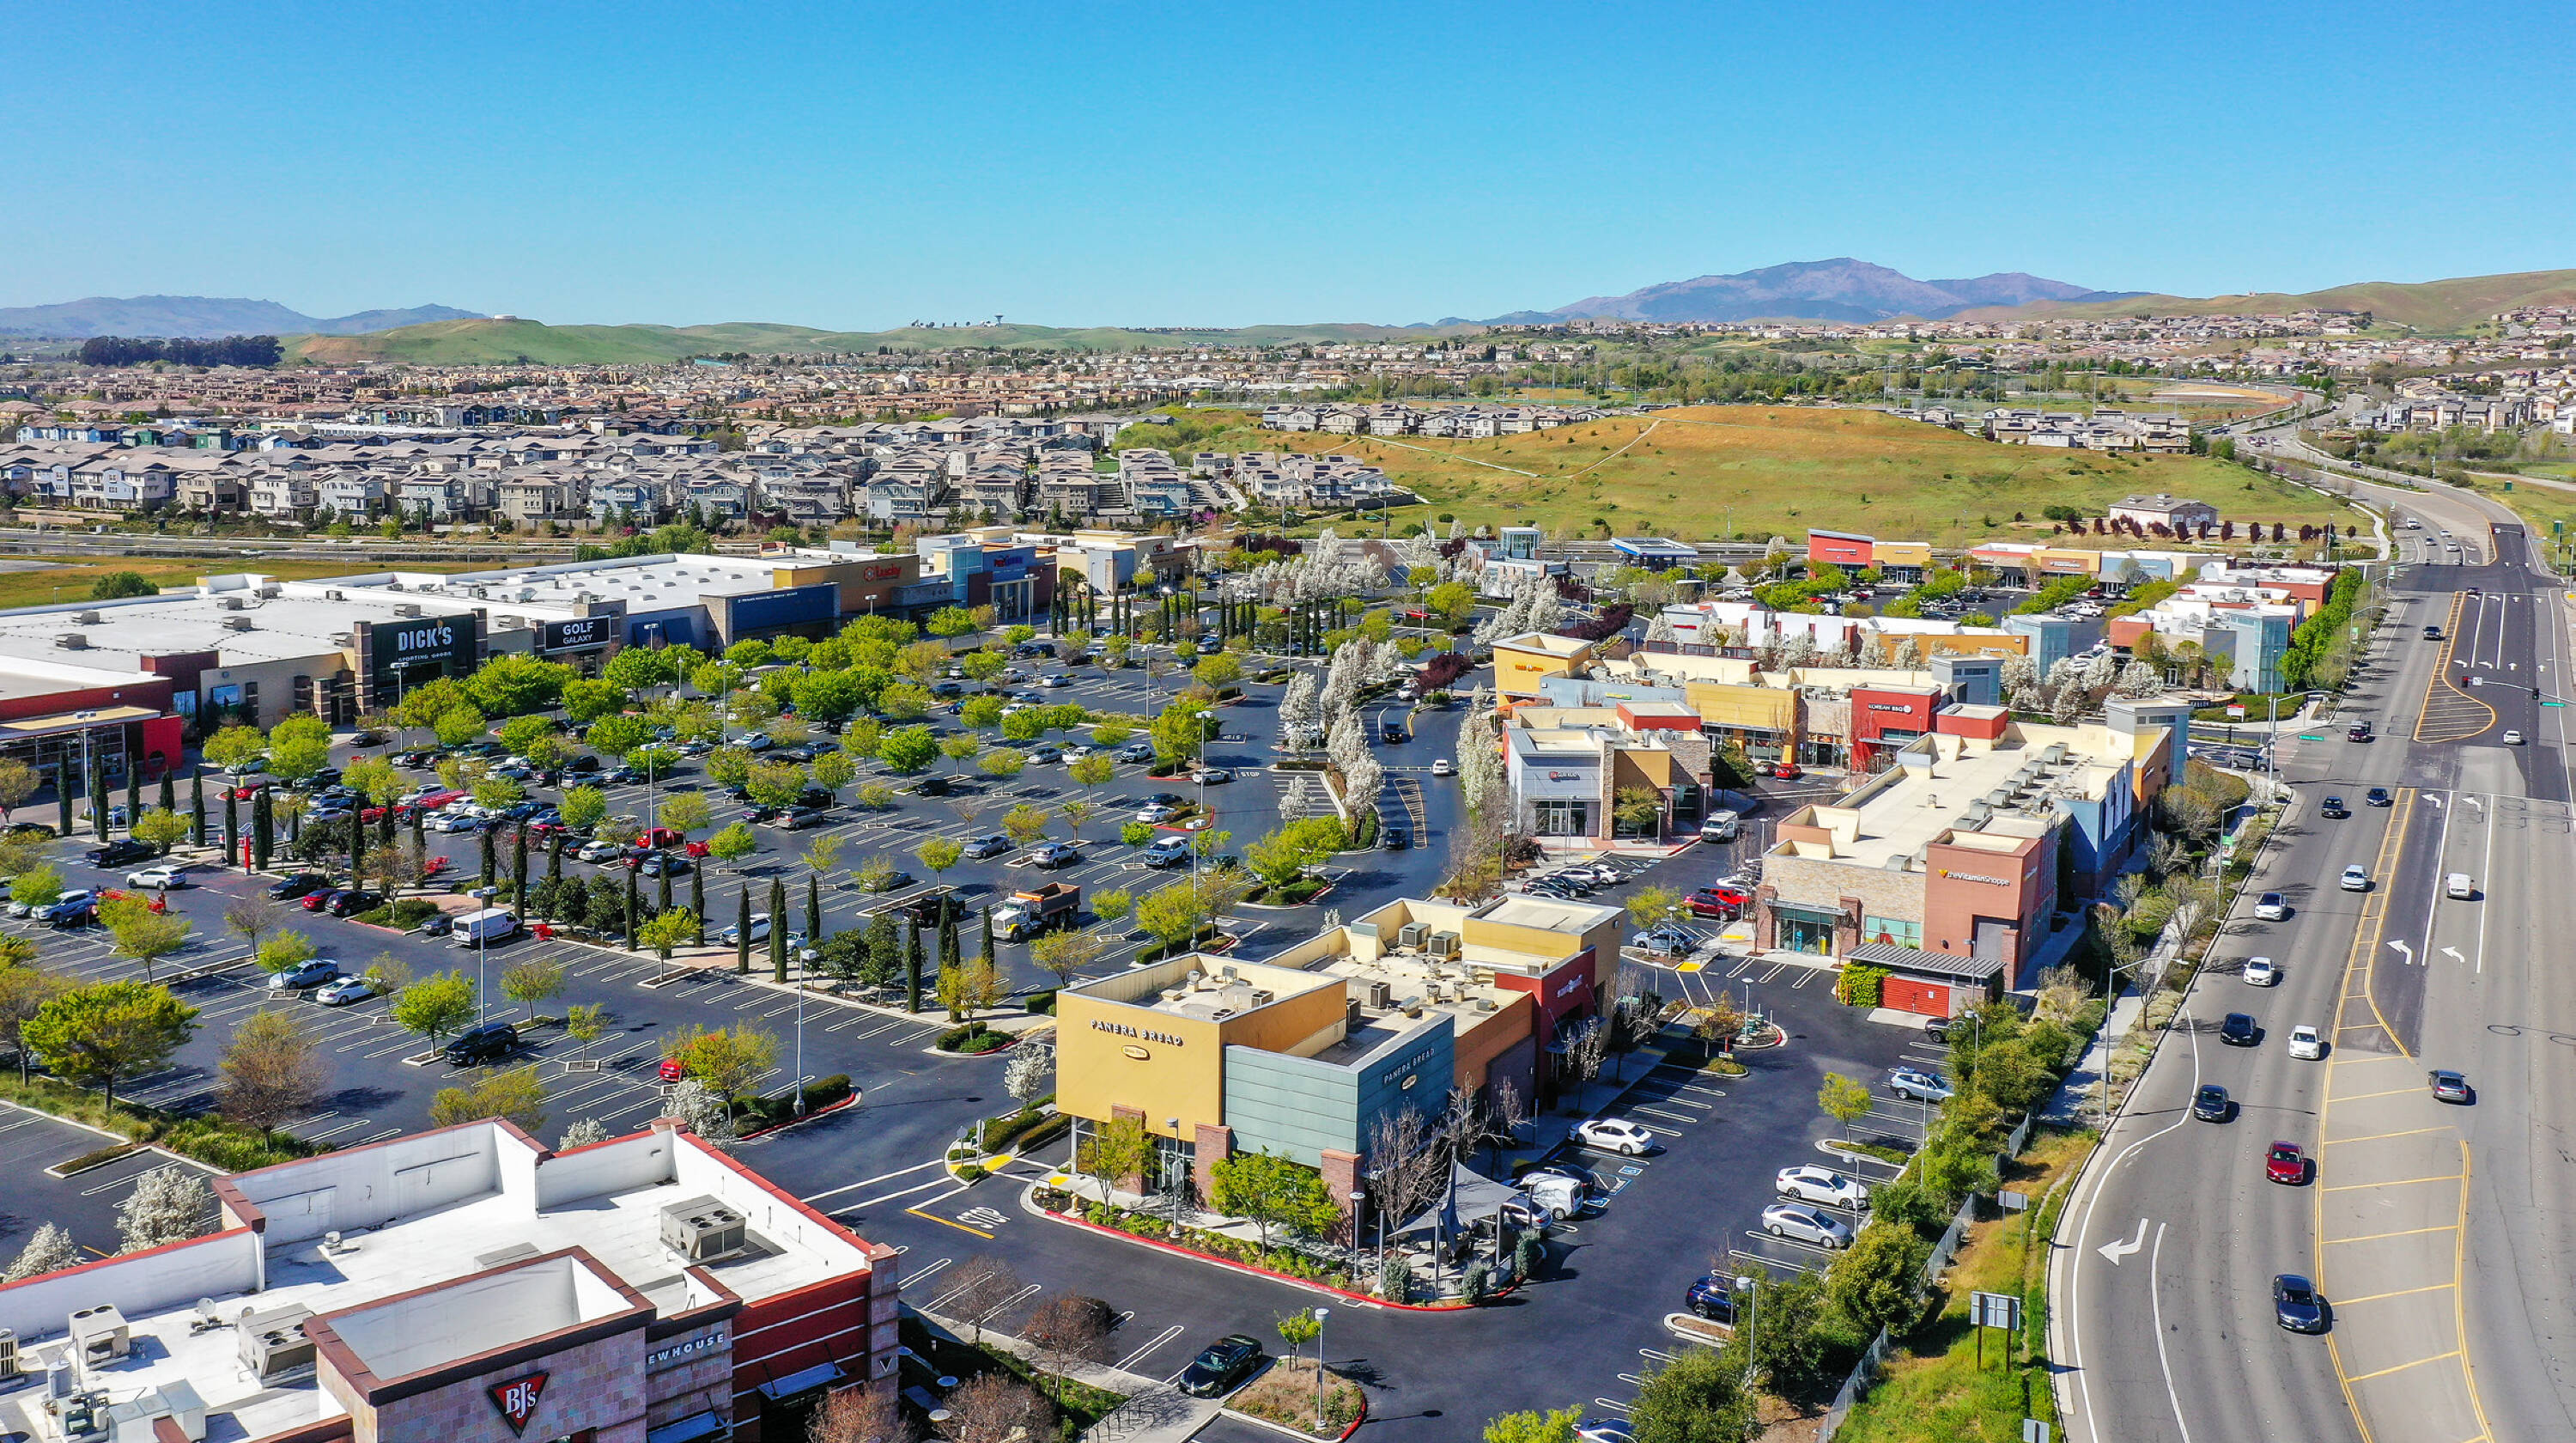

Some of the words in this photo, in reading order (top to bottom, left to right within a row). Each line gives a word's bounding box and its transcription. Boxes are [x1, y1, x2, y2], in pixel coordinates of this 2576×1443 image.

[398, 626, 452, 651] DICK'S
[562, 622, 594, 636] GOLF
[562, 634, 592, 644] GALAXY
[1091, 1020, 1138, 1038] PANERA
[1140, 1030, 1183, 1047] BREAD
[1383, 1062, 1411, 1085] PANERA
[1413, 1048, 1435, 1067] BREAD
[956, 1206, 1011, 1230] STOP
[647, 1333, 724, 1365] EWHOUSE
[505, 1381, 536, 1419] BJ's
